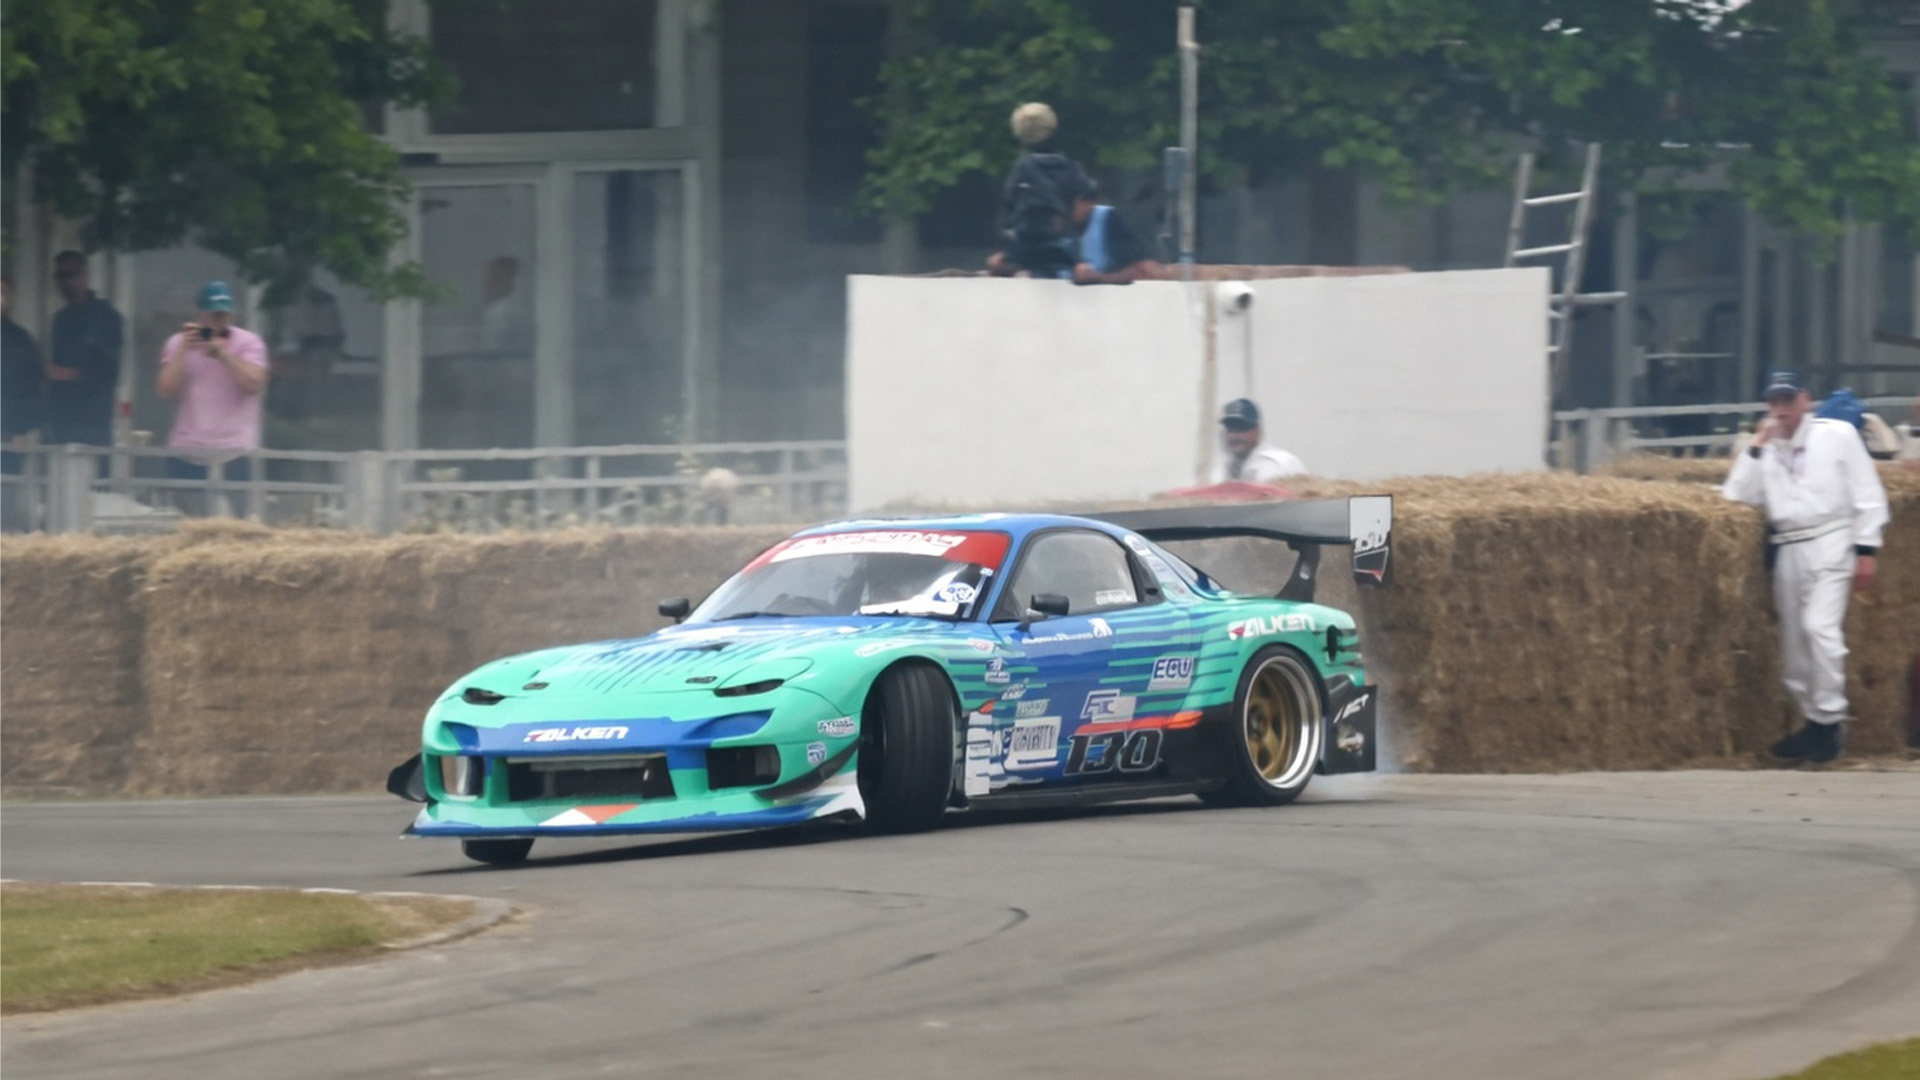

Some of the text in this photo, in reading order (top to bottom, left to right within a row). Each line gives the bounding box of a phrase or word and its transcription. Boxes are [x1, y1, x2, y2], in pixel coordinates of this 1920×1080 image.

[1228, 613, 1316, 640] FALKEN
[1153, 656, 1192, 679] ECU
[523, 726, 629, 742] FALKEN
[1062, 728, 1164, 777] 130
